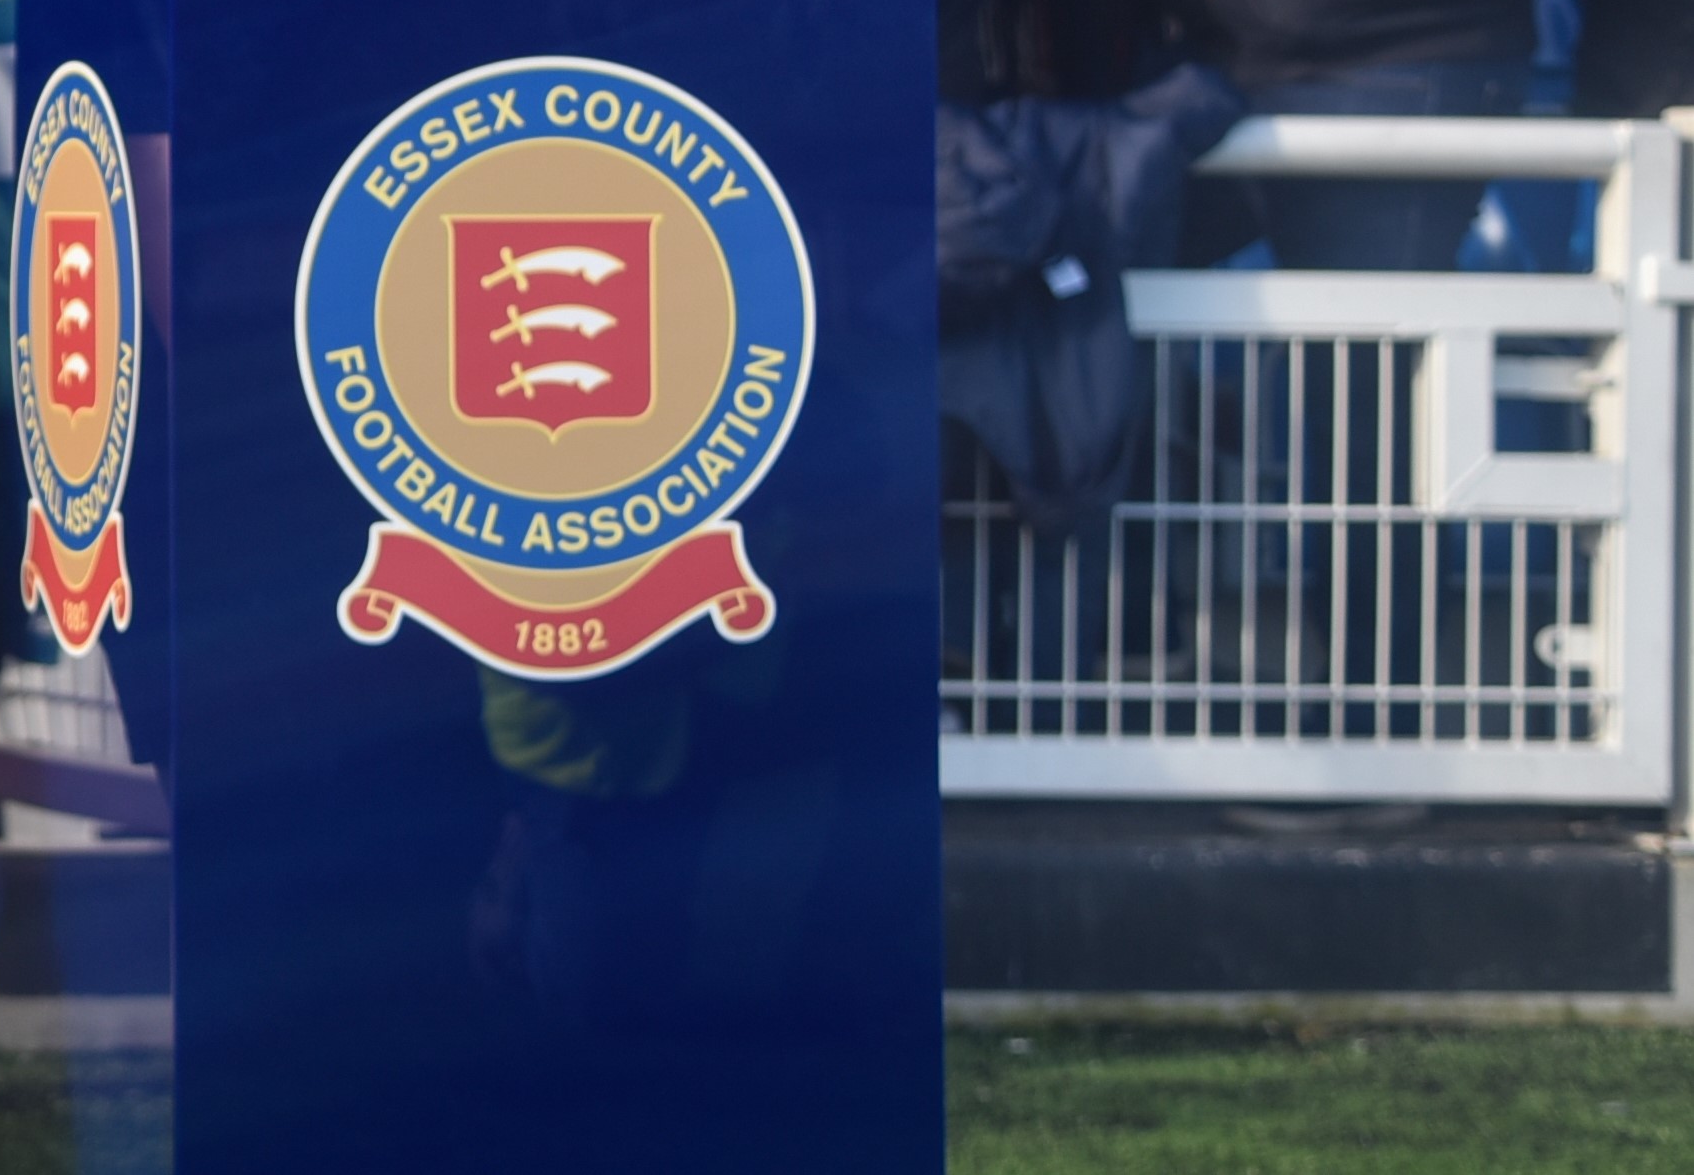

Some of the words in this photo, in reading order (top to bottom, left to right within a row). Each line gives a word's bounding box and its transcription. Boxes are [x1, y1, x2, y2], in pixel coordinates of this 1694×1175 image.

[26, 92, 68, 207] ESSEX
[69, 88, 123, 206] COUNTY
[363, 88, 525, 210] ESSEX
[544, 84, 749, 209] COUNTY
[17, 334, 63, 524] FOOTBALL
[64, 342, 133, 537] ASSOCIATION
[325, 345, 506, 546] FOOTBALL
[522, 344, 787, 554] ASSOCIATION
[514, 618, 608, 656] 1882
